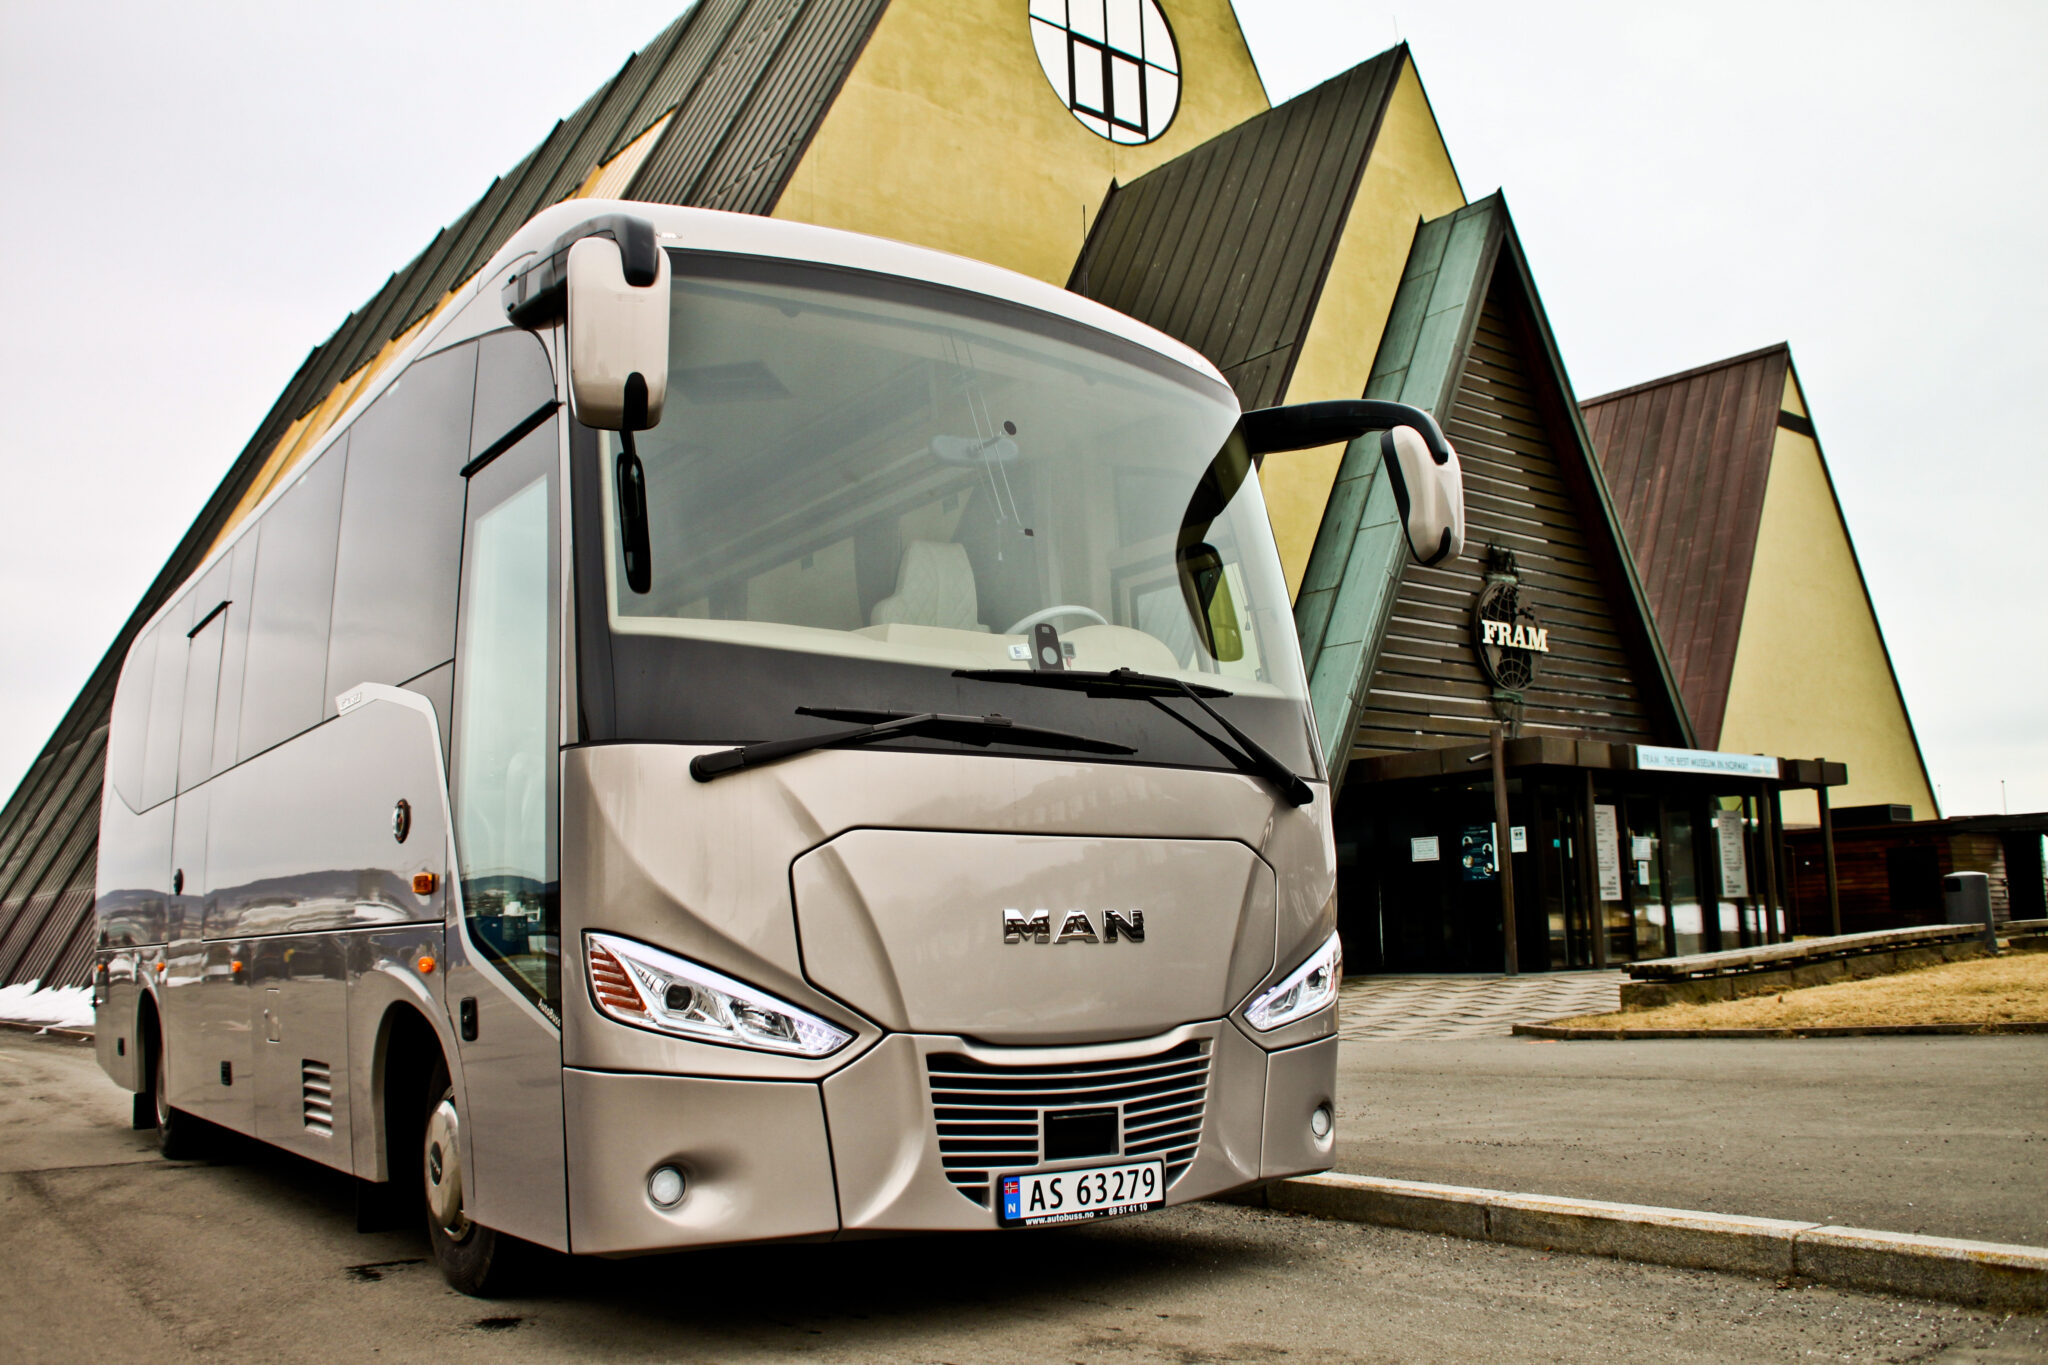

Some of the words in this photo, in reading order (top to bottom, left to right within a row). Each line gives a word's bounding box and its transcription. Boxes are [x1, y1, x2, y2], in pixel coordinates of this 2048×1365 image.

[1481, 619, 1550, 653] FRAM
[1003, 908, 1145, 944] MAN
[1029, 1177, 1064, 1212] AS
[1076, 1167, 1156, 1206] 63279
[1007, 1202, 1017, 1214] N
[1025, 1211, 1095, 1226] www.autobuss.no
[1108, 1205, 1118, 1216] 69
[1128, 1203, 1138, 1214] 41
[1139, 1203, 1148, 1212] 10
